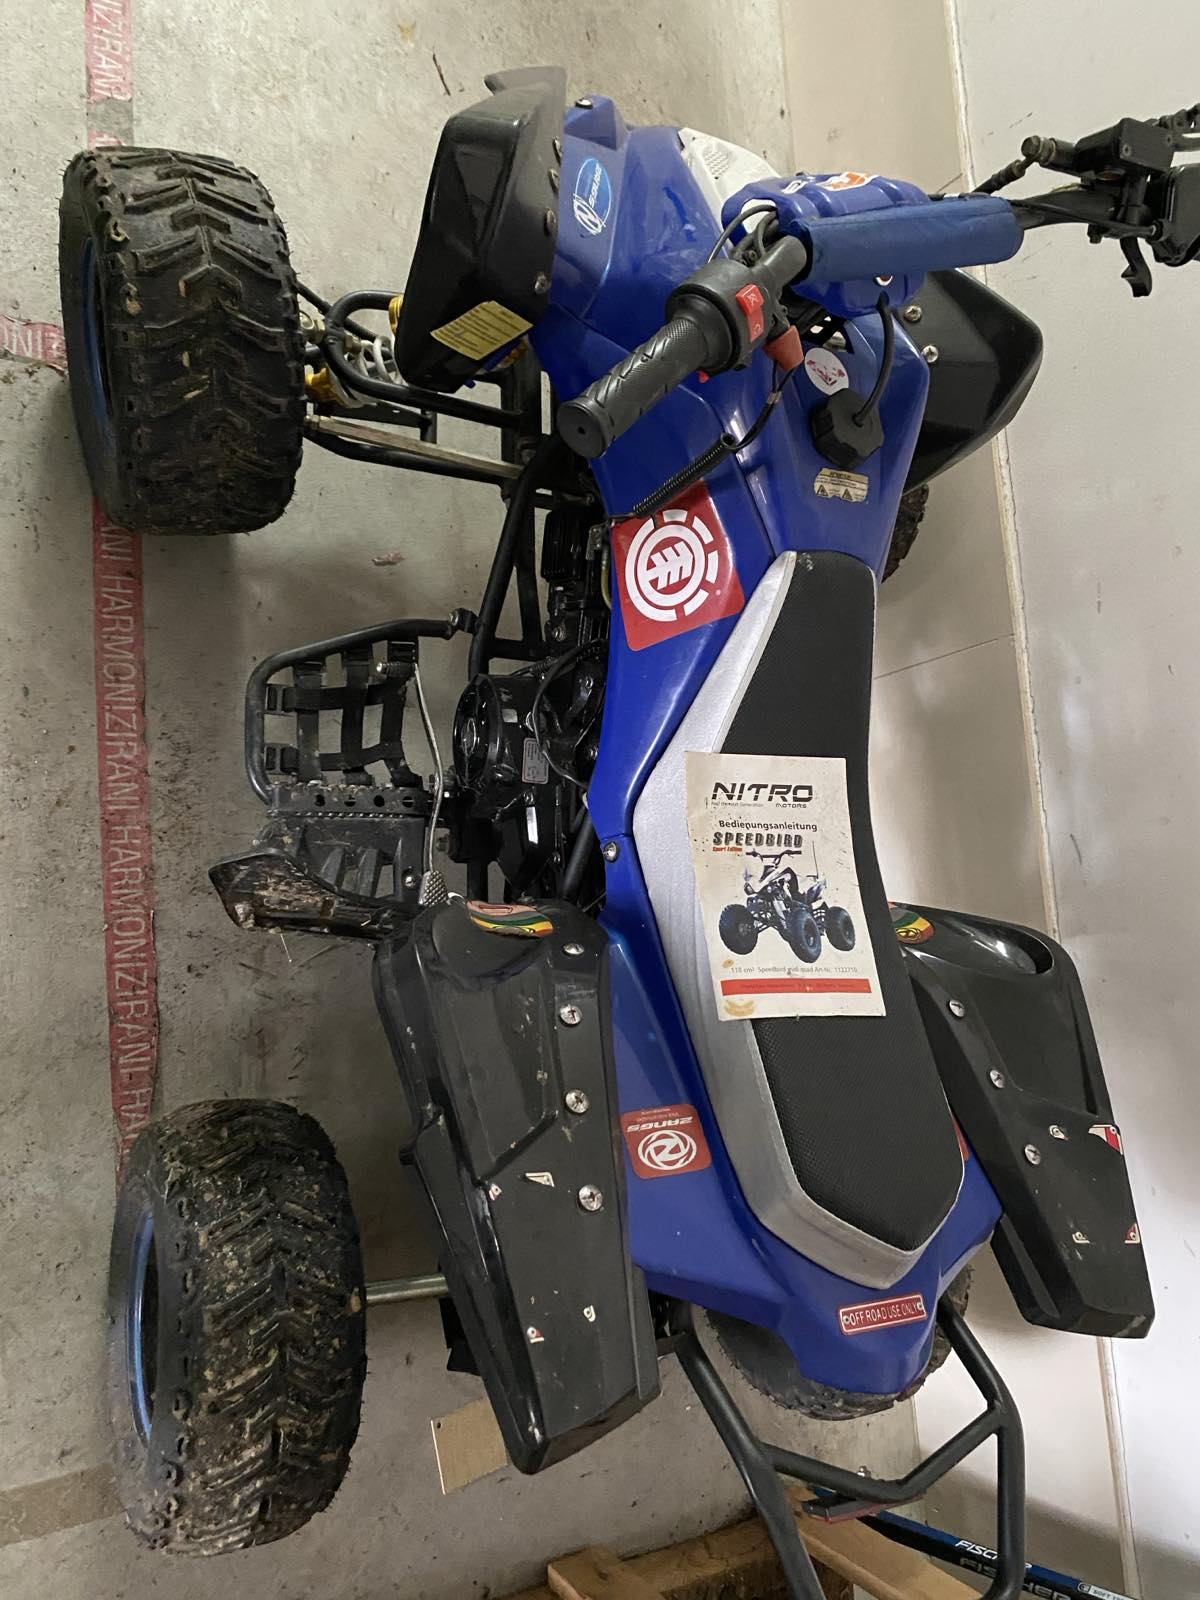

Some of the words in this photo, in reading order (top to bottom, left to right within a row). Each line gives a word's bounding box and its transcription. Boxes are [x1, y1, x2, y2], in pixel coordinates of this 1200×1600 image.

[102, 575, 140, 810] HARMONIZIRANI
[711, 782, 813, 802] NITRO
[719, 820, 817, 832] Bedienungsanleitung
[713, 832, 803, 848] SPEEDBIRD
[849, 1311, 864, 1326] OFF
[865, 1307, 887, 1322] ROAD
[887, 1304, 901, 1318] USE
[901, 1302, 917, 1316] ONLY
